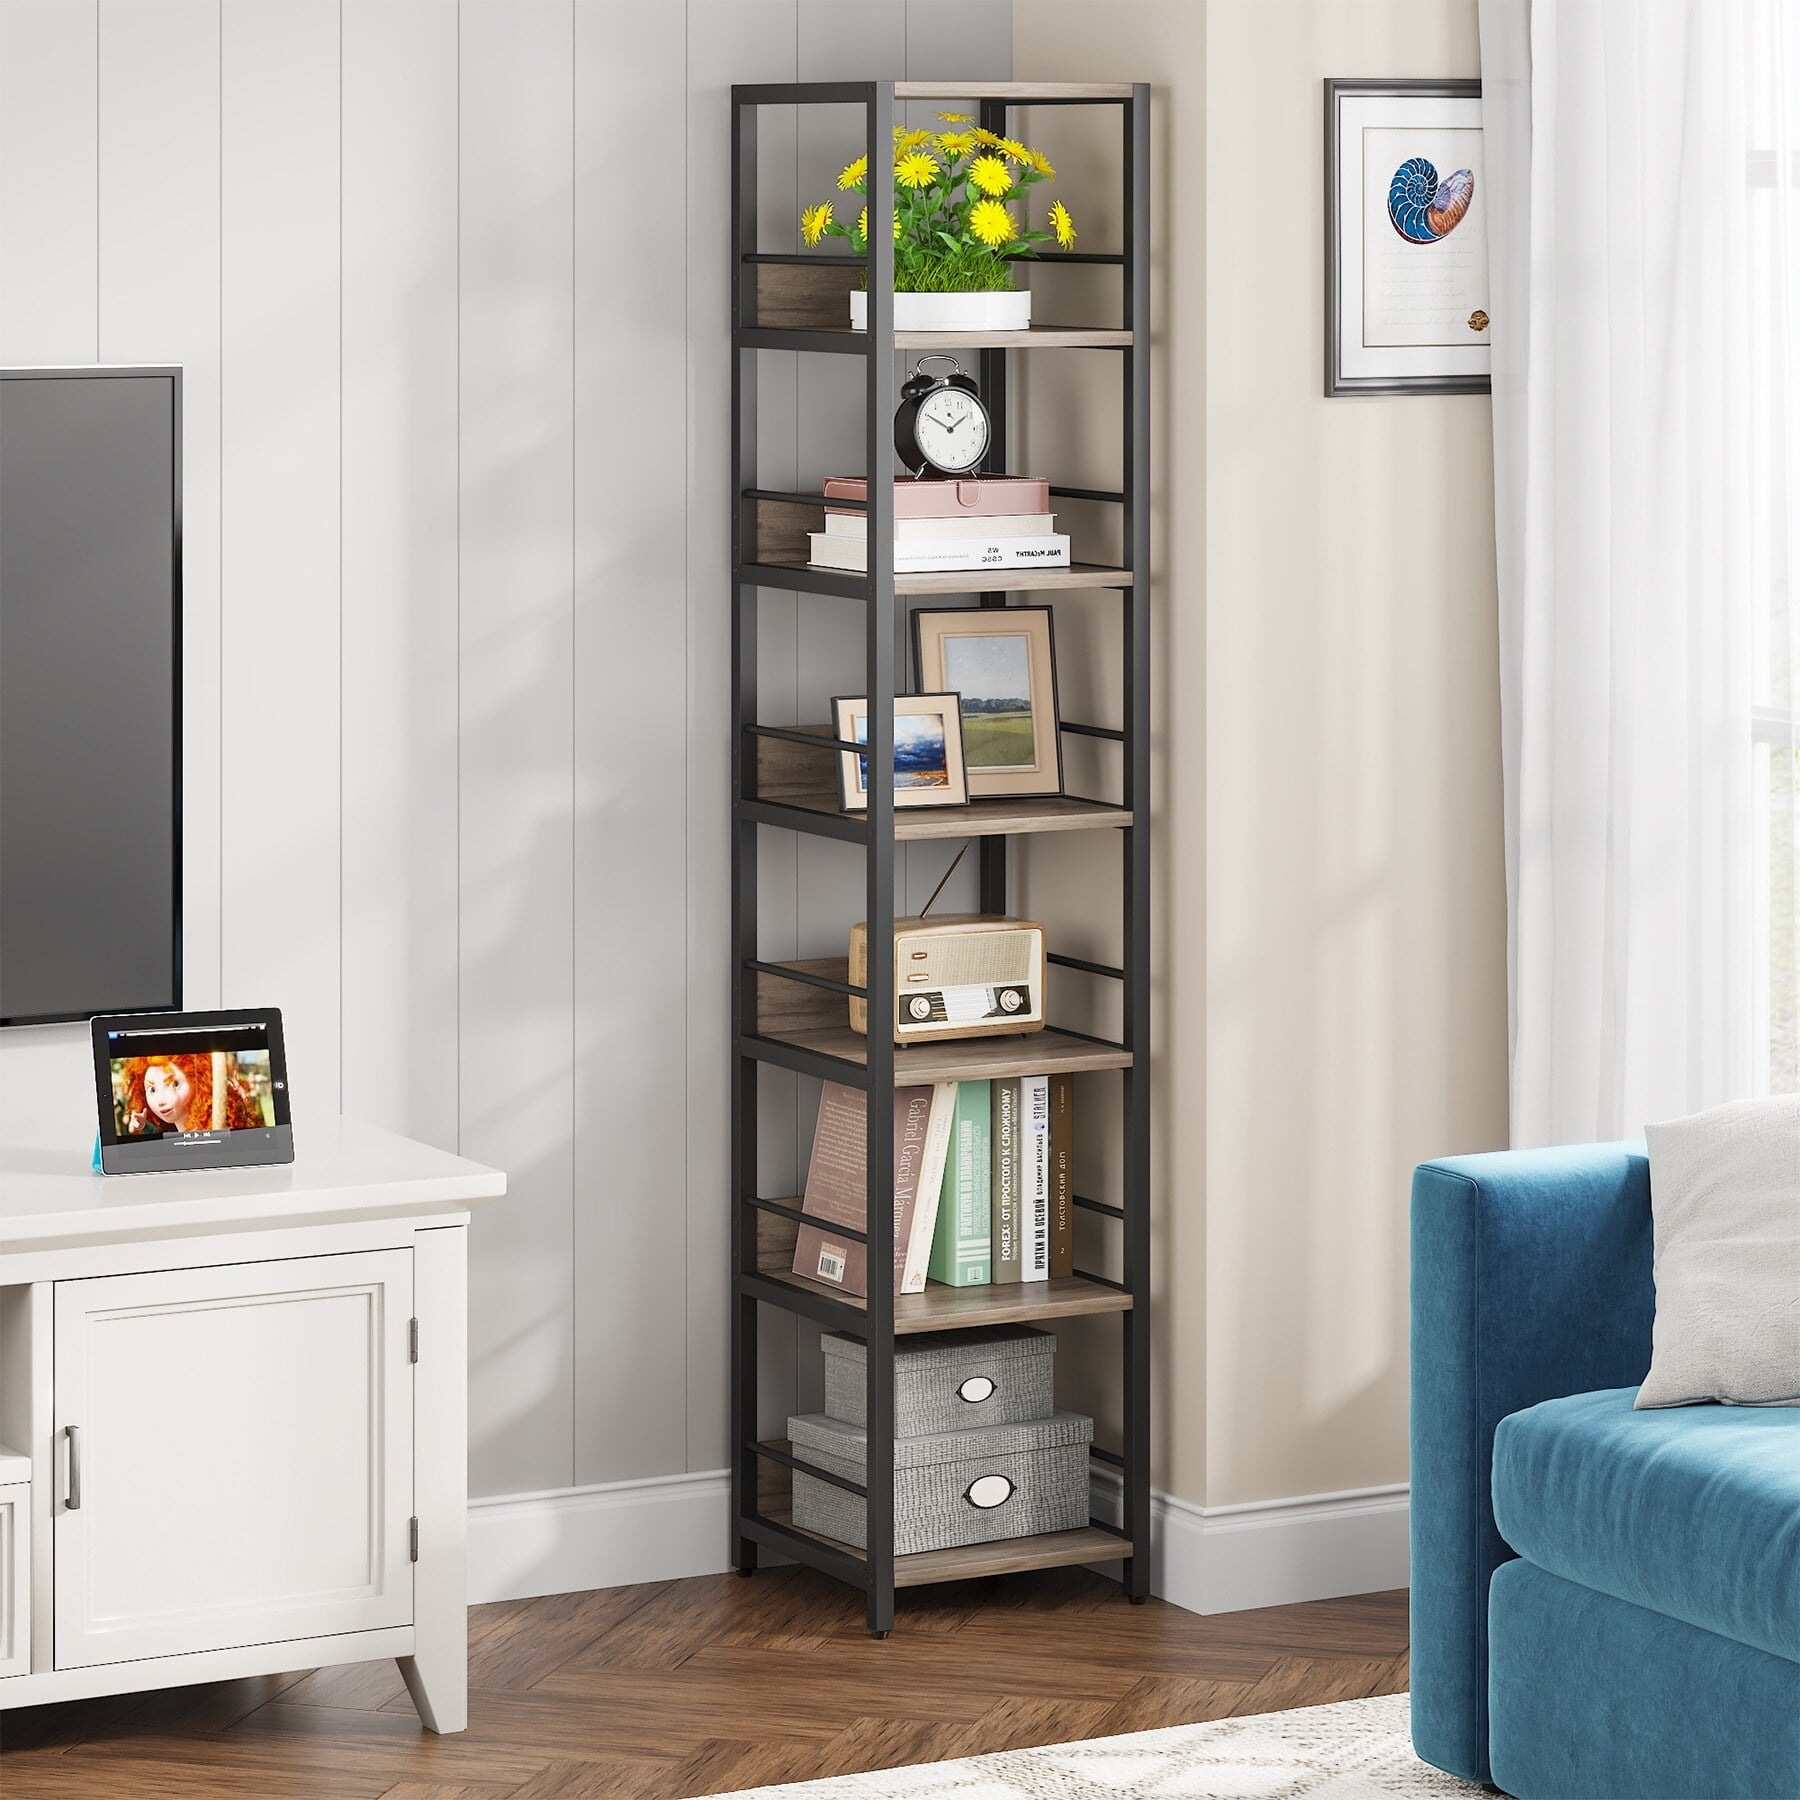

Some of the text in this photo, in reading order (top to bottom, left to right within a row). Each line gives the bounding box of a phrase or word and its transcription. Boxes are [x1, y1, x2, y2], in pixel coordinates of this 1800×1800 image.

[904, 1098, 928, 1140] Gabriel
[1002, 1088, 1011, 1146] СЛОЖНОМУ
[896, 1145, 920, 1184] García
[1002, 1158, 1010, 1206] ПРОСТОГО
[960, 1193, 973, 1236] ПРАКТИКУМ
[1002, 1208, 1010, 1220] ОТ
[1032, 1198, 1045, 1226] ОСЕВОЙ
[1002, 1224, 1010, 1260] FOREX:
[1034, 1228, 1045, 1239] НА
[1034, 1242, 1045, 1270] ПРЯТКИ
